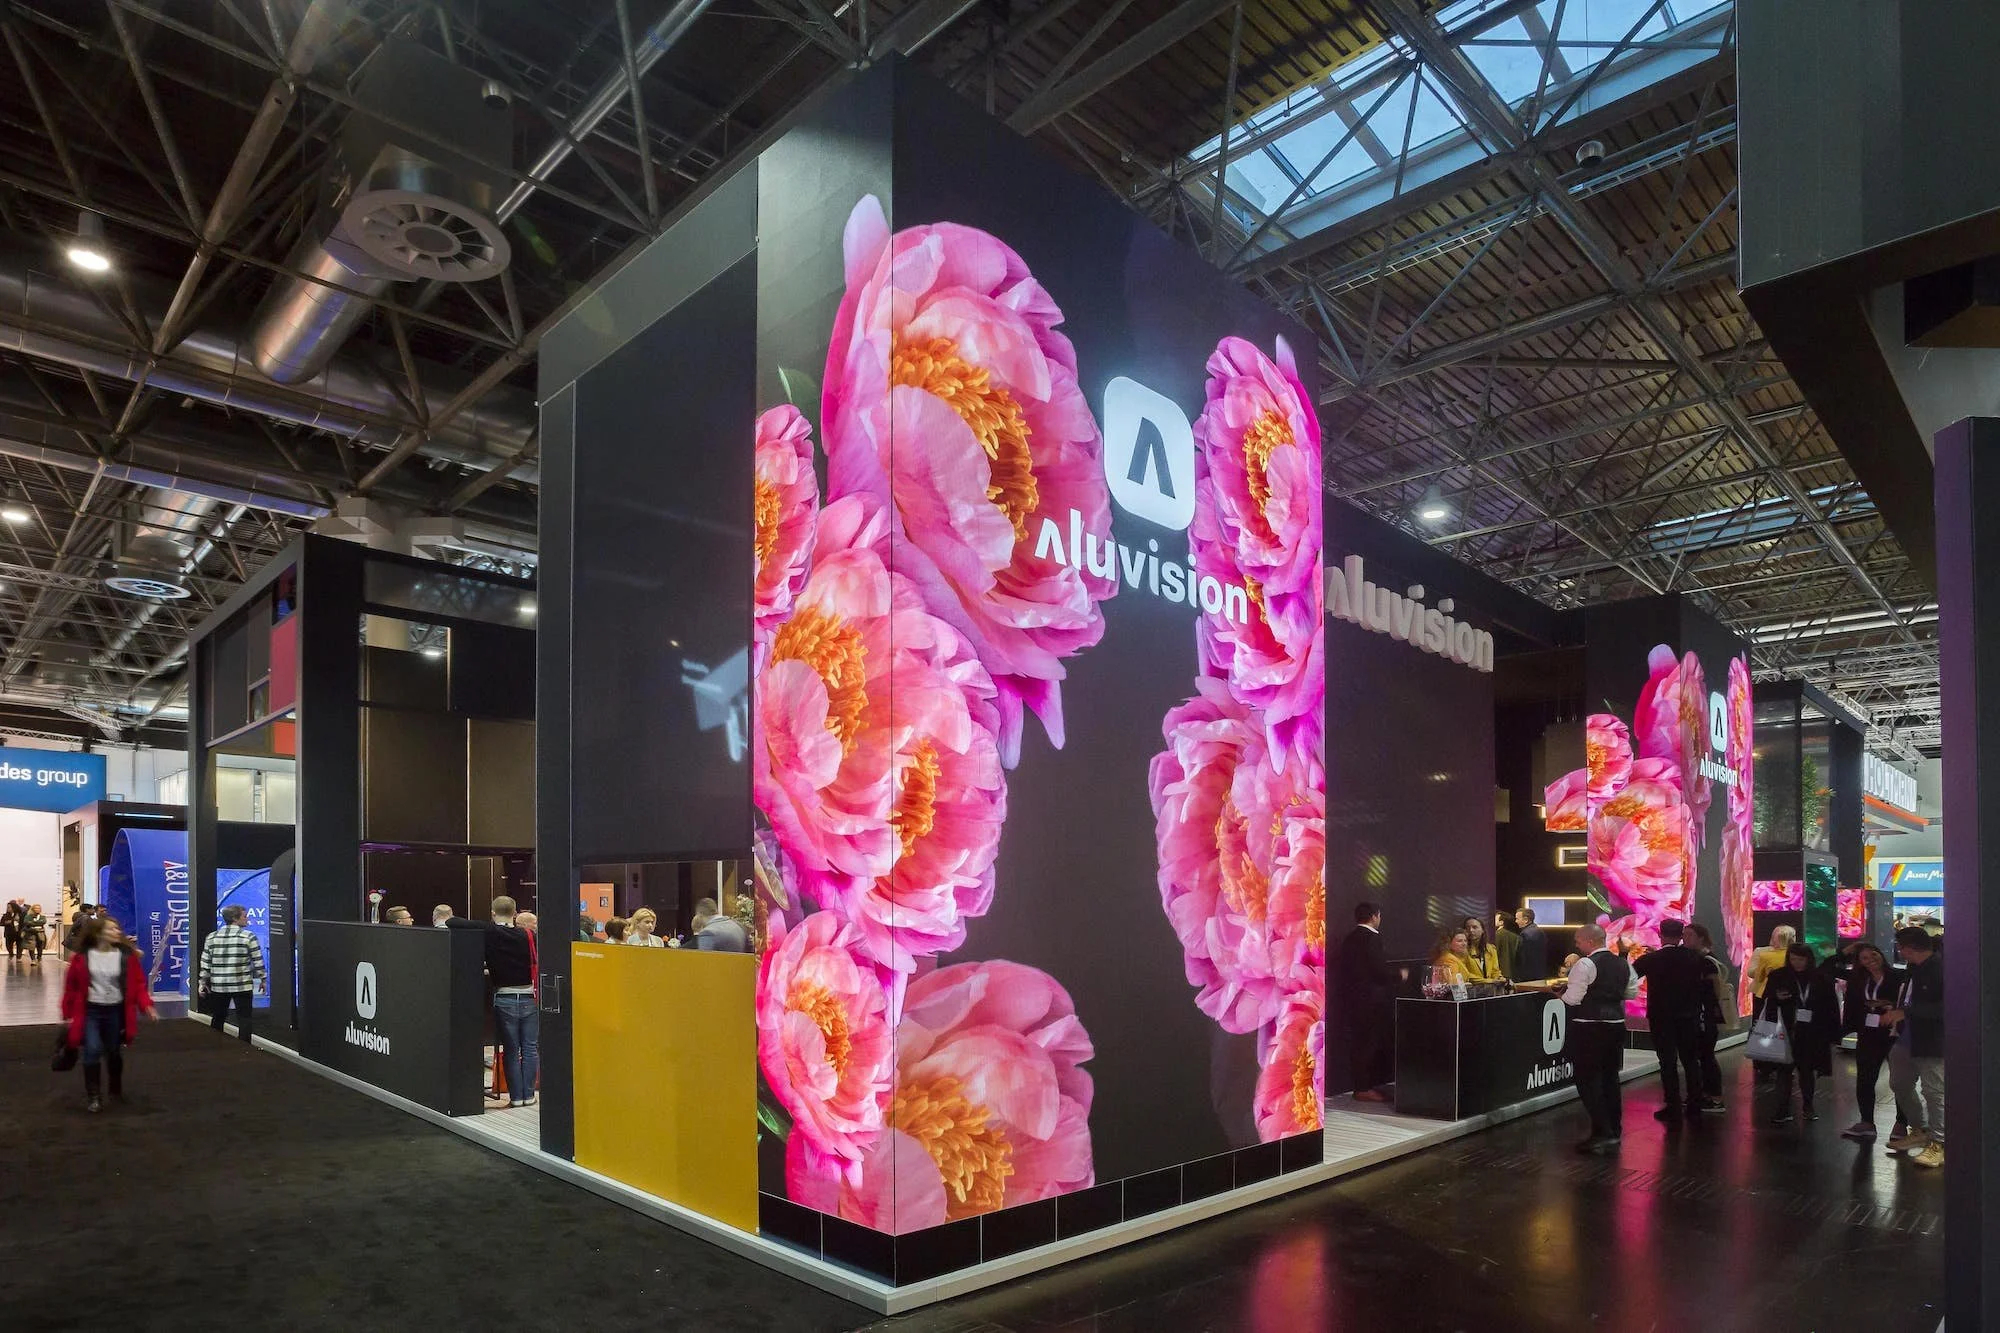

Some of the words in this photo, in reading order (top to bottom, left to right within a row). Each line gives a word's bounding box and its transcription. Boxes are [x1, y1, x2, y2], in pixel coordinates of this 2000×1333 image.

[1034, 508, 1249, 624] Aluvision
[1323, 555, 1494, 672] Aluvision
[36, 769, 88, 788] group
[1699, 752, 1738, 787] Aluvision
[345, 1020, 391, 1056] Aluvision
